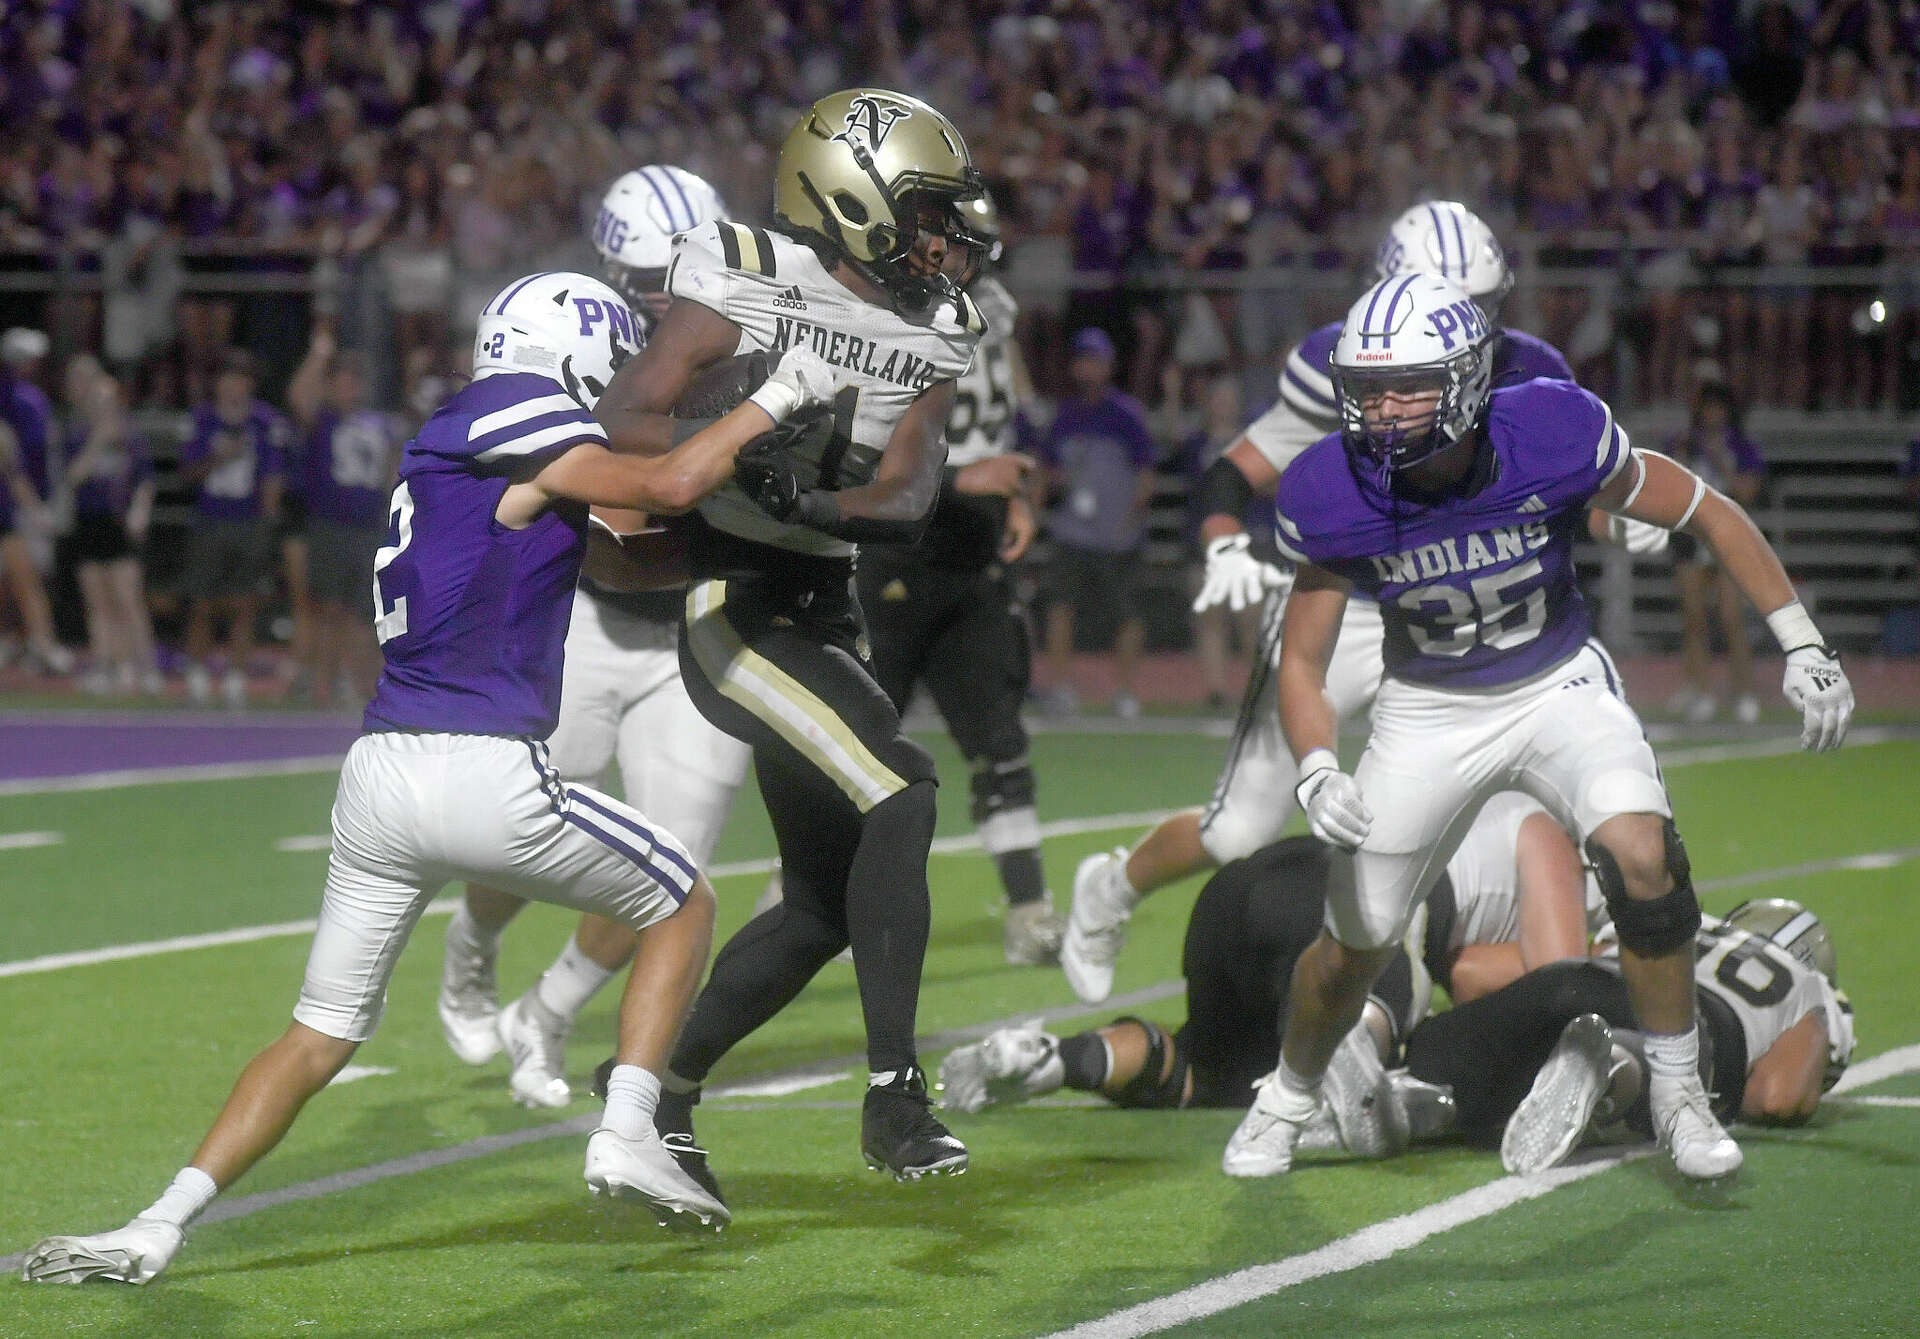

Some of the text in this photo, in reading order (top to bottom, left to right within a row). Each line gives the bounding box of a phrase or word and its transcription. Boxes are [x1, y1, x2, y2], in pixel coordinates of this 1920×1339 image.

[595, 207, 629, 253] NG
[772, 298, 808, 311] adidas
[490, 332, 505, 359] 2
[771, 317, 936, 390] NEDERLAND
[1356, 352, 1392, 361] Riddell
[372, 480, 415, 647] 2
[1369, 520, 1549, 584] INDIANS
[1398, 558, 1547, 657] 35
